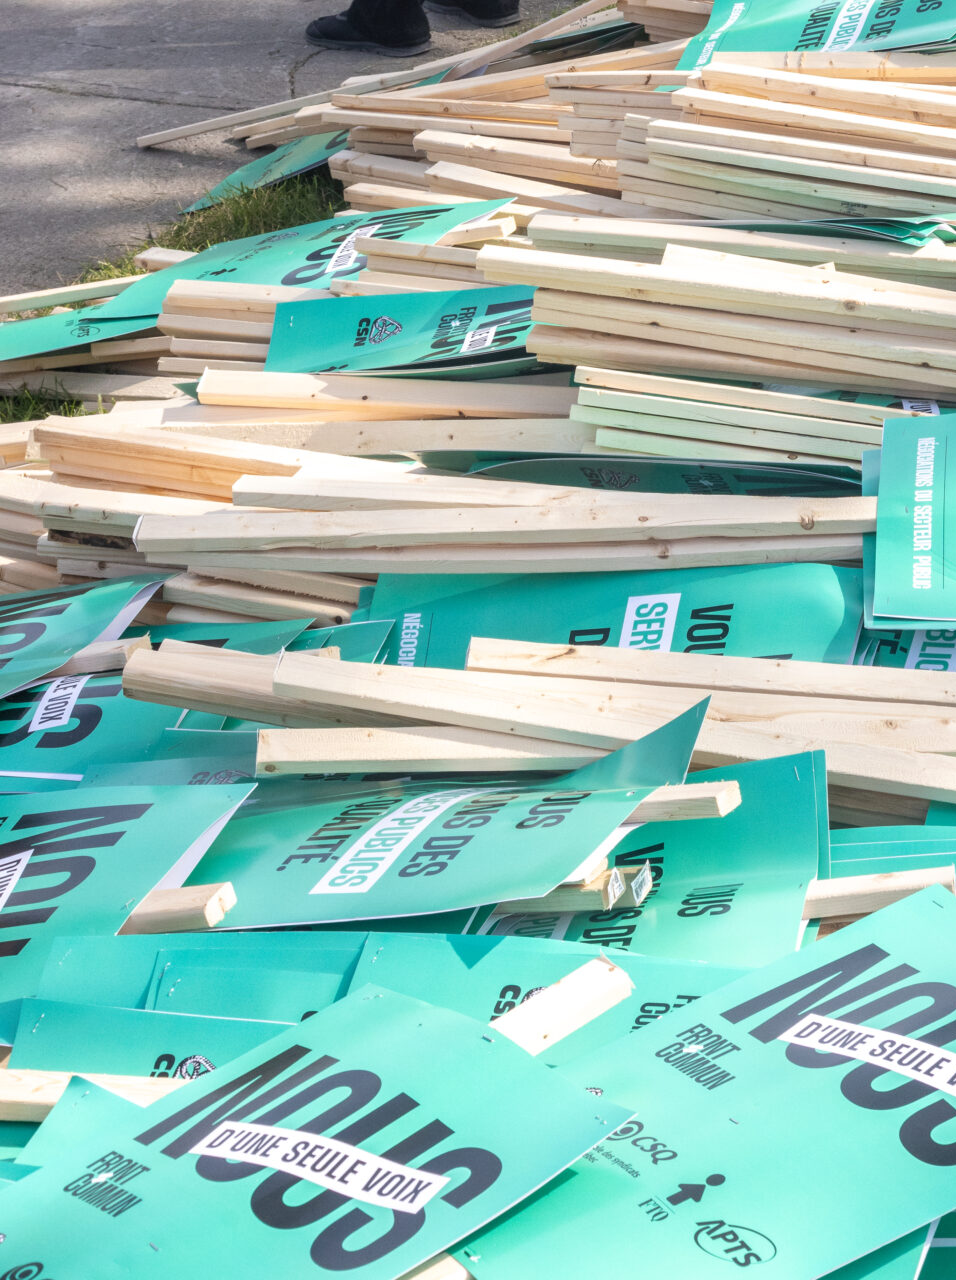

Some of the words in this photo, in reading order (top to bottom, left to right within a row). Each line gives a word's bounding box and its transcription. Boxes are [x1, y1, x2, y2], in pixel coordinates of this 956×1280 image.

[824, 12, 861, 51] PUBLIC
[353, 317, 371, 348] CSN
[914, 436, 940, 488] NÉGOCIATIONS
[914, 489, 933, 502] DU
[913, 505, 933, 552] SECTEUR
[912, 555, 933, 590] PUBLIC
[397, 612, 422, 667] NÉGOCIA
[38, 694, 71, 725] VOIX
[516, 790, 593, 830] OUS
[328, 816, 421, 889] PUBLICS
[398, 834, 475, 879] DES
[491, 984, 521, 1021] CS
[676, 1023, 741, 1058] FRONT
[795, 1021, 872, 1055] D'UNE
[868, 1040, 951, 1080] SEULE
[655, 1041, 737, 1091] COMMUN
[86, 1150, 151, 1186] FRONT
[133, 1044, 503, 1271] NOUS
[206, 1129, 287, 1159] D'UNE
[280, 1140, 366, 1185] SEULE
[363, 1170, 434, 1205] VOIX
[613, 1156, 641, 1179] syndicats
[631, 1136, 678, 1165] CSQ
[63, 1172, 144, 1218] COMMUN
[638, 1197, 669, 1223] FTQ
[695, 1219, 763, 1267] APTS
